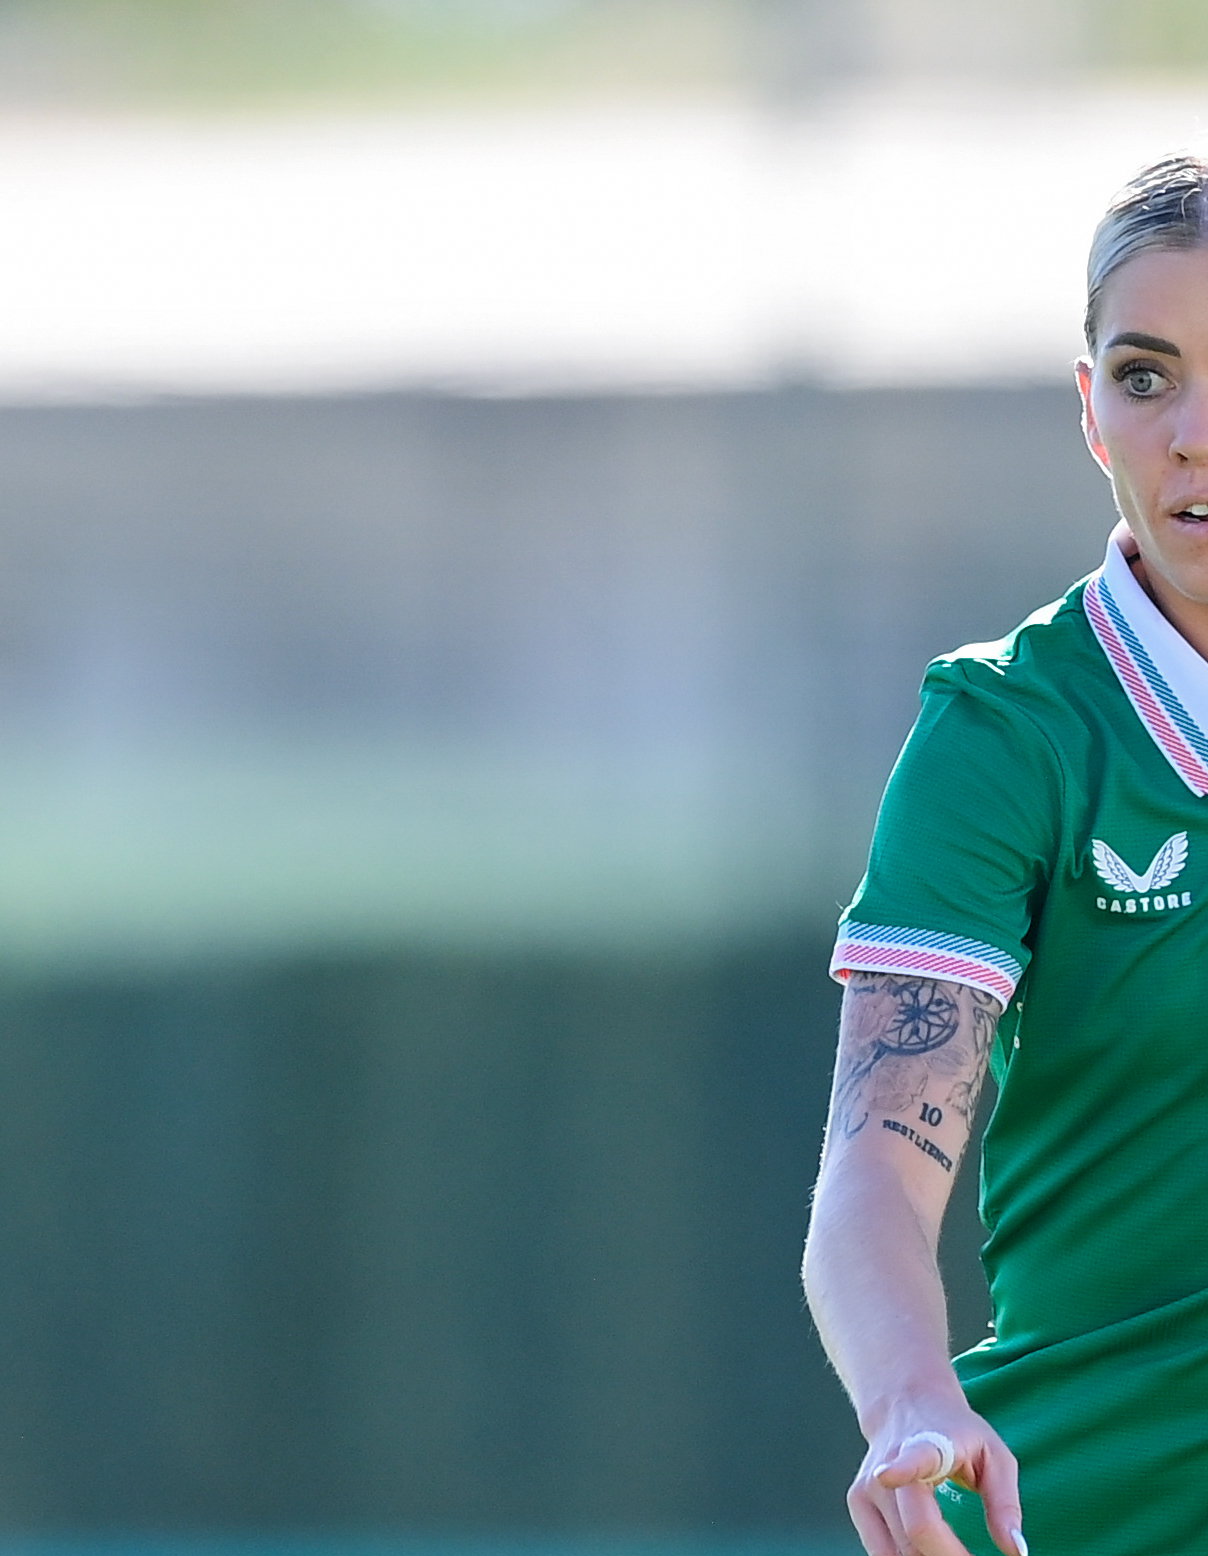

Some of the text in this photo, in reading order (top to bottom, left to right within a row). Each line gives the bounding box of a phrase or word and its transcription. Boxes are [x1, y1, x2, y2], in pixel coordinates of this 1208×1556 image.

[1096, 891, 1192, 914] CASTORE
[918, 1102, 943, 1128] 10
[882, 1118, 953, 1173] RESILIENCE
